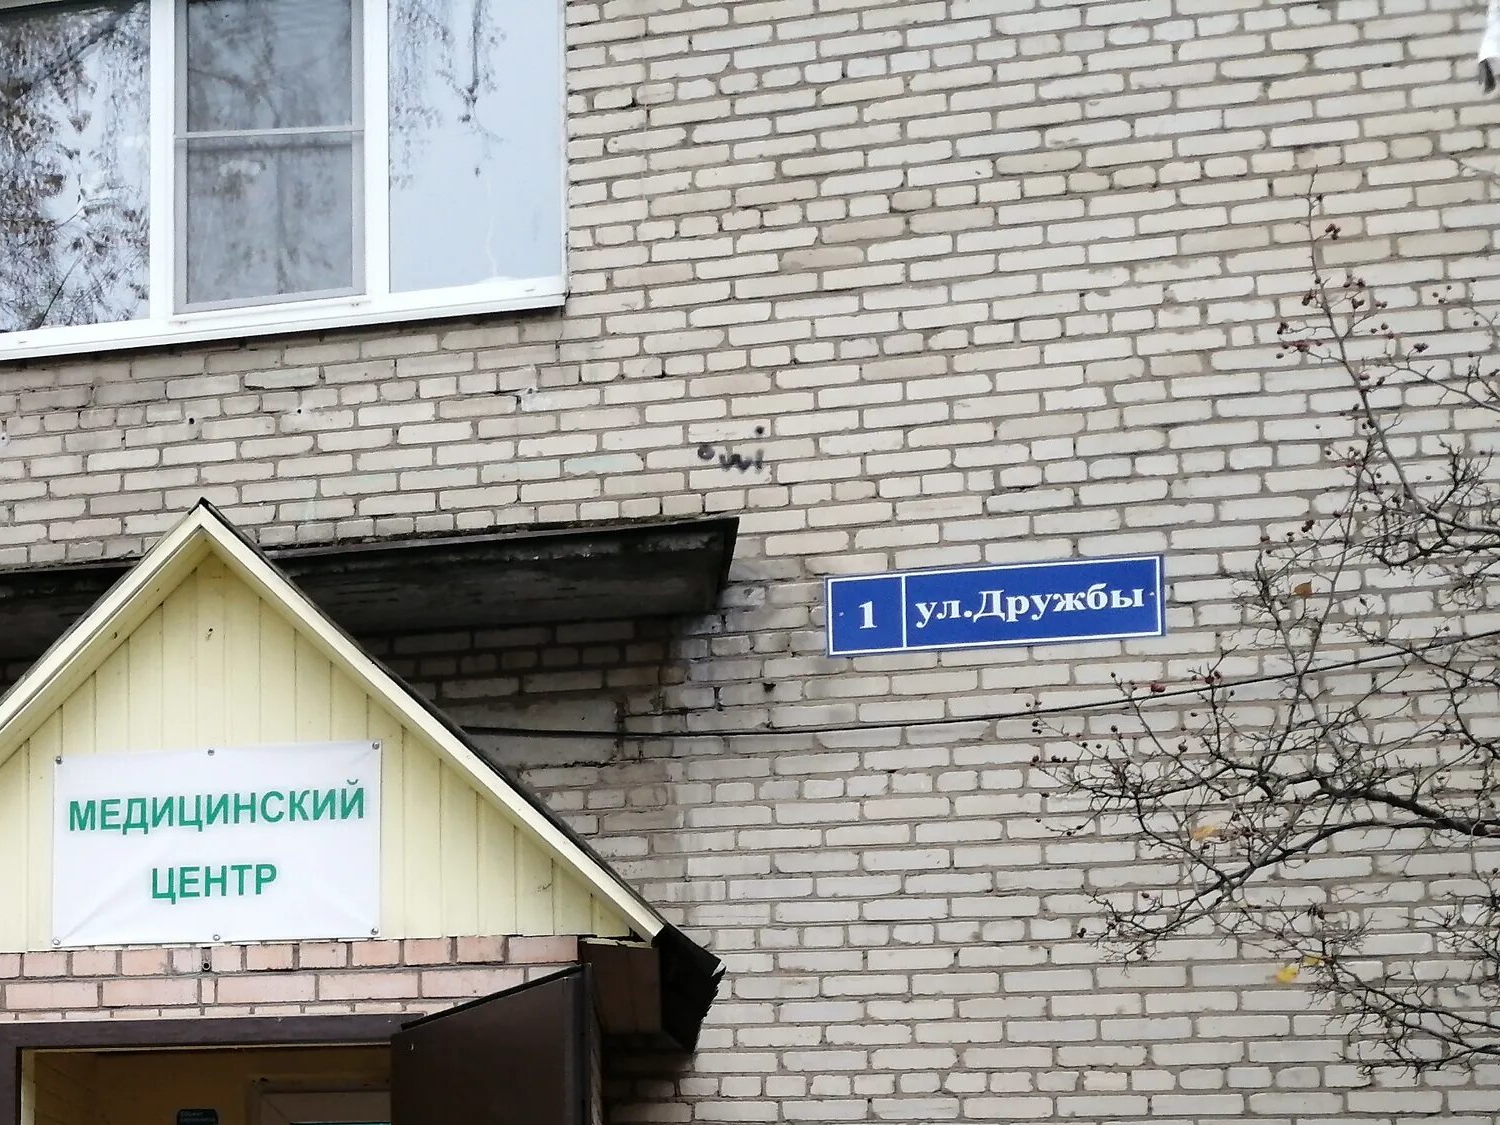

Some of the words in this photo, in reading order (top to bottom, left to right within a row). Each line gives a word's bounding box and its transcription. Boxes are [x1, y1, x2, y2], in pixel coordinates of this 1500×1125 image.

[859, 600, 877, 629] 1
[915, 582, 1145, 629] ул.Дружбы
[69, 778, 365, 835] МЕДИЦИНСКИЙ
[152, 863, 277, 905] ЦЕНТР
